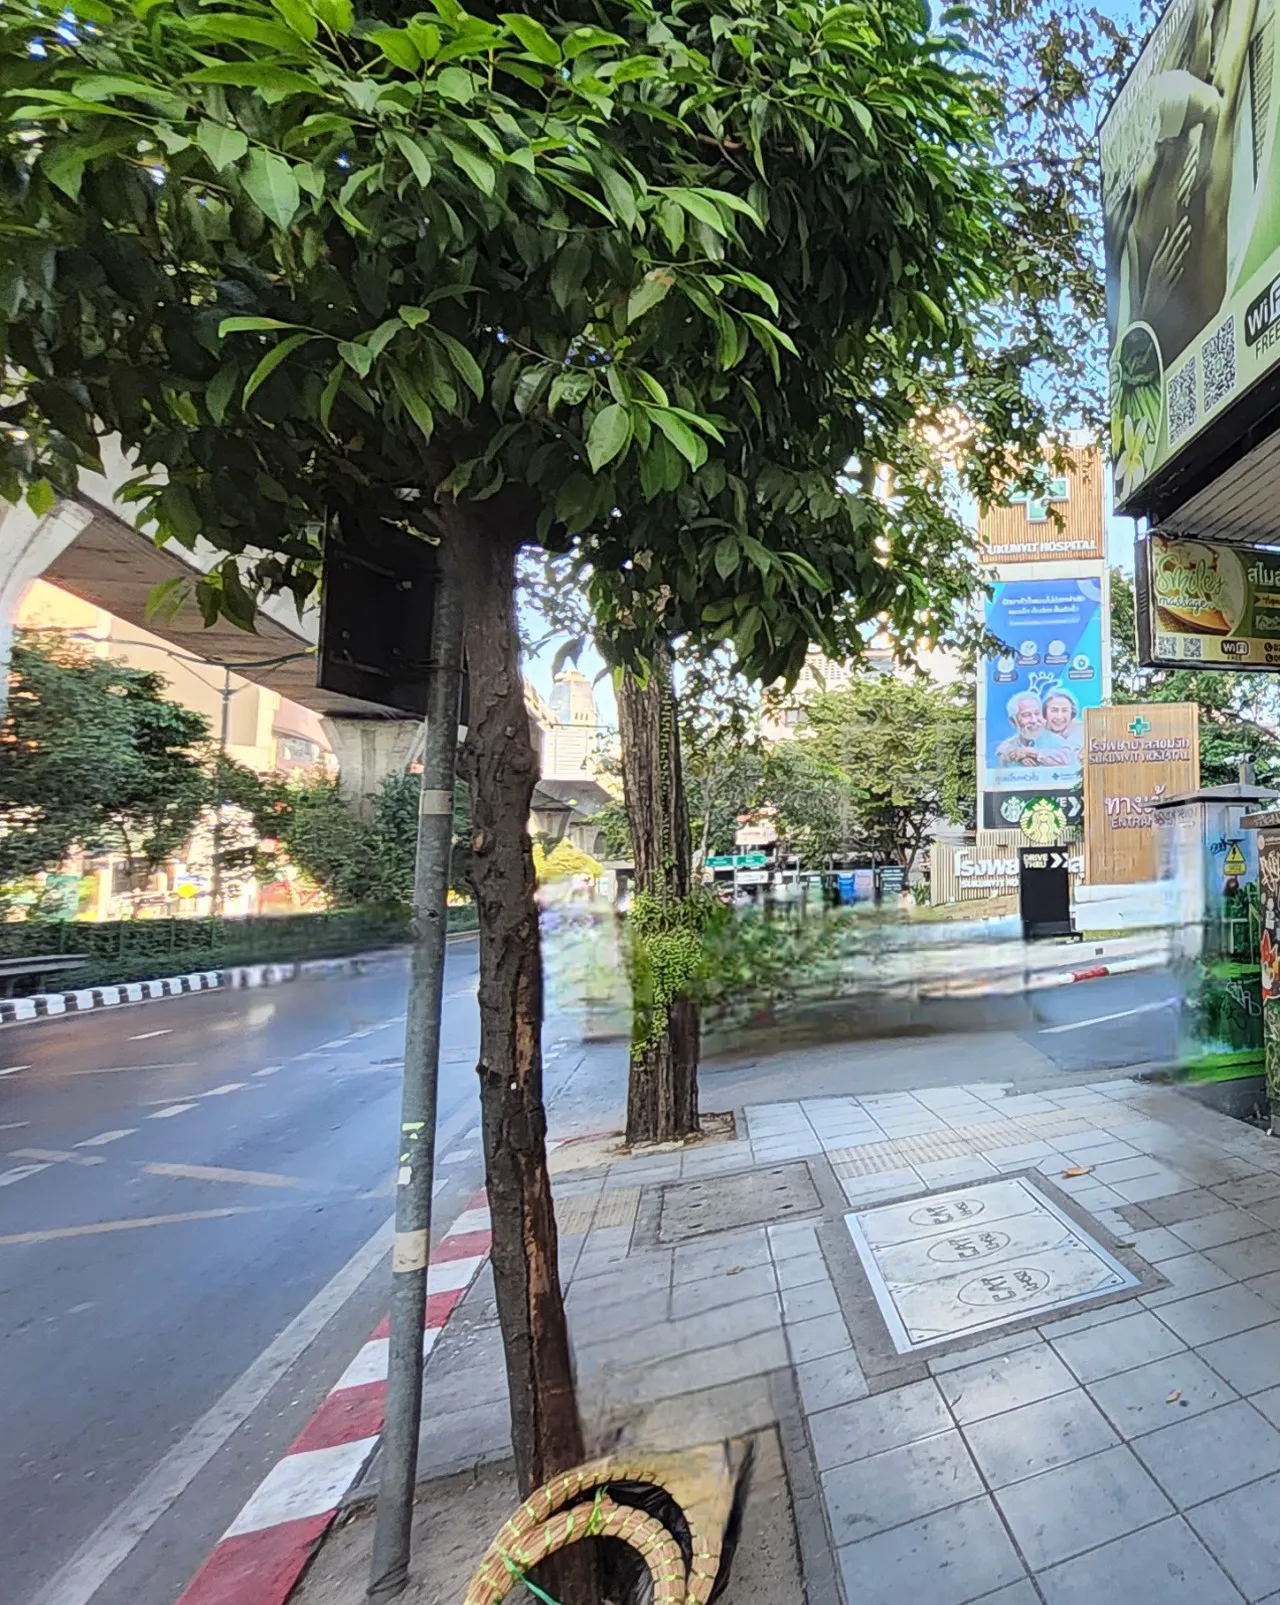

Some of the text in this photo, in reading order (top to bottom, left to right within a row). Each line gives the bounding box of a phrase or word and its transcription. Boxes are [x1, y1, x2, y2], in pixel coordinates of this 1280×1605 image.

[986, 542, 1039, 555] UKUMVIT
[1023, 852, 1049, 861] DRIVE
[1024, 860, 1048, 869] THRU
[980, 1275, 1017, 1302] CAT
